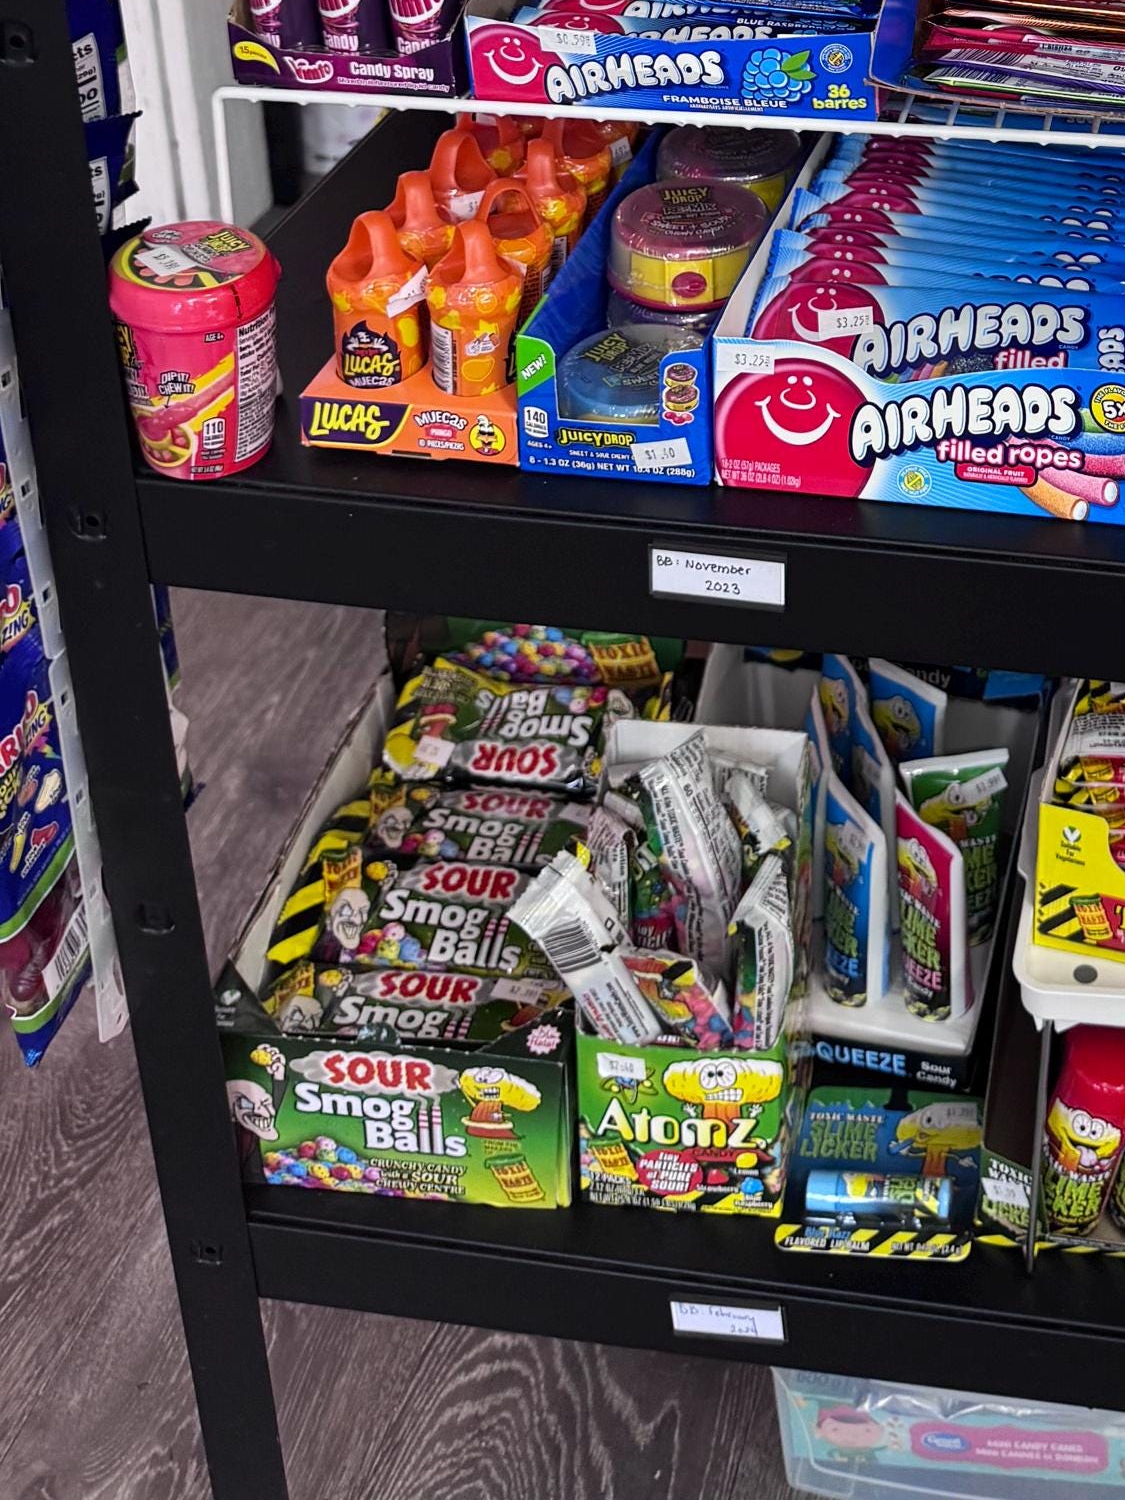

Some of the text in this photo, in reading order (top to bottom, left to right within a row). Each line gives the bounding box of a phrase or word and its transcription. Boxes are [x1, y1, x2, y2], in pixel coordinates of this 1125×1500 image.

[350, 61, 434, 83] Candy Spray
[545, 51, 725, 104] AIRHEADS
[663, 94, 787, 109] FRAMBOISE BLEUE
[812, 83, 867, 111] 36 barres
[521, 354, 547, 380] NEW!
[205, 420, 224, 434] 110
[309, 401, 390, 440] LUCAS
[525, 409, 546, 425] 140
[852, 386, 1076, 461] AIRHEADS
[603, 434, 634, 446] DROP
[936, 441, 1083, 472] filled ropes
[685, 559, 751, 575] November
[705, 580, 740, 595] 2023
[323, 1053, 432, 1091] SOUR
[295, 1082, 415, 1130] Smog
[364, 1110, 468, 1157] Balls
[597, 1098, 762, 1149] Atomz
